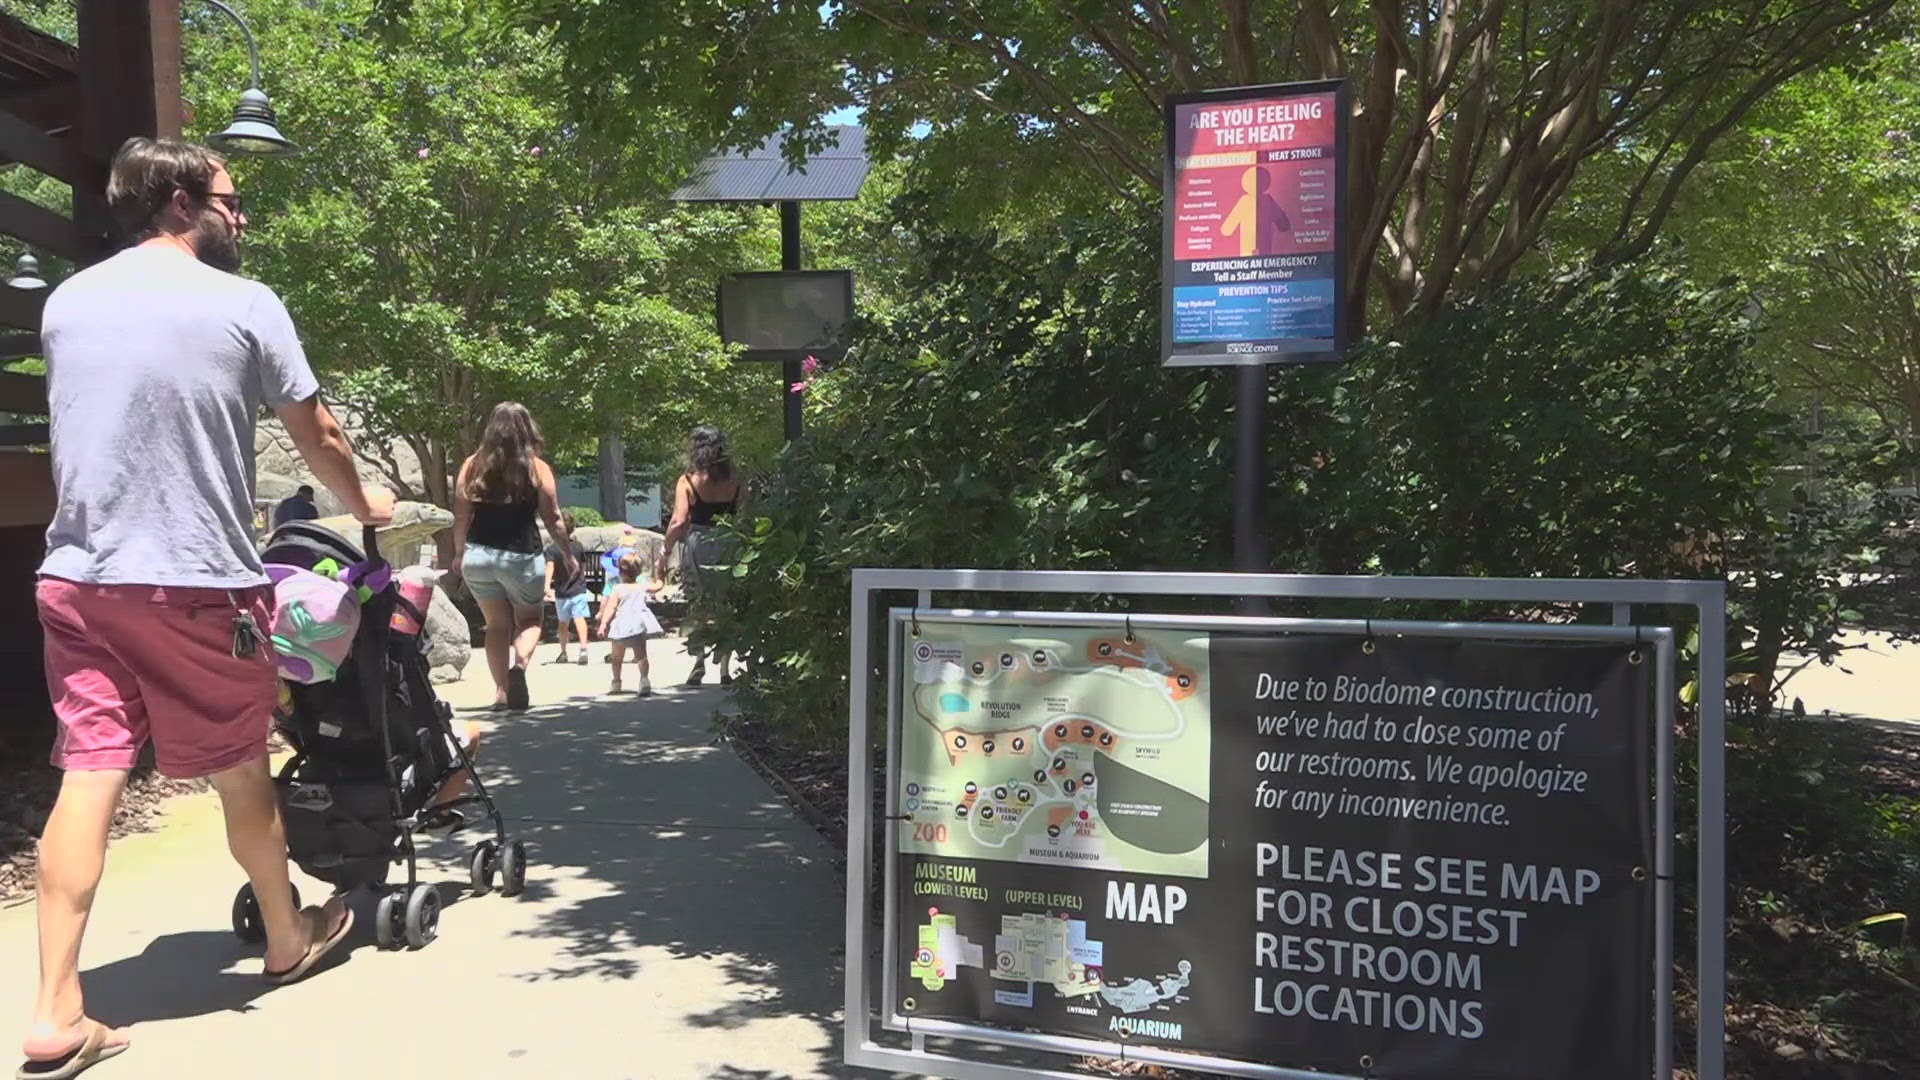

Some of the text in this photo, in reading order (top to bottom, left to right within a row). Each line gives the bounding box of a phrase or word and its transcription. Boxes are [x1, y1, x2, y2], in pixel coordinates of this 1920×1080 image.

[1190, 102, 1322, 129] ARE YOU FEELING
[1214, 124, 1295, 146] THE HEAT?
[1269, 148, 1322, 161] HEAT STROKE
[1191, 255, 1319, 272] EXPERIENCING AN EMERGENCY?
[1214, 269, 1293, 283] Tell a Staff Member
[1218, 284, 1289, 297] PREVENTION TIPS
[1253, 345, 1279, 353] CENTER
[981, 701, 1021, 711] REVOLUTION
[1255, 672, 1599, 719] Due to Biodome construction,
[991, 711, 1011, 719] RIDGE
[1256, 710, 1567, 752] we've had to close some of
[1255, 750, 1588, 797] our restrooms. We apologize
[1255, 780, 1511, 826] for any inconvenience.
[913, 822, 947, 843] ZOO
[1029, 847, 1100, 861] MUSEUM & AQUARIUM
[915, 863, 977, 883] MUSEUM
[1256, 842, 1601, 905] PLEASE SEE MAP
[914, 881, 988, 902] (LOWER LEVEL)
[1005, 889, 1083, 911] (UPPER LEVEL)
[1105, 880, 1188, 925] MAP
[1256, 887, 1528, 947] FOR CLOSEST
[1255, 932, 1482, 991] RESTROOM
[1067, 1005, 1099, 1017] ENTRANCE
[1254, 977, 1484, 1040] LOCATIONS
[1109, 1015, 1182, 1040] AQUARIUM
